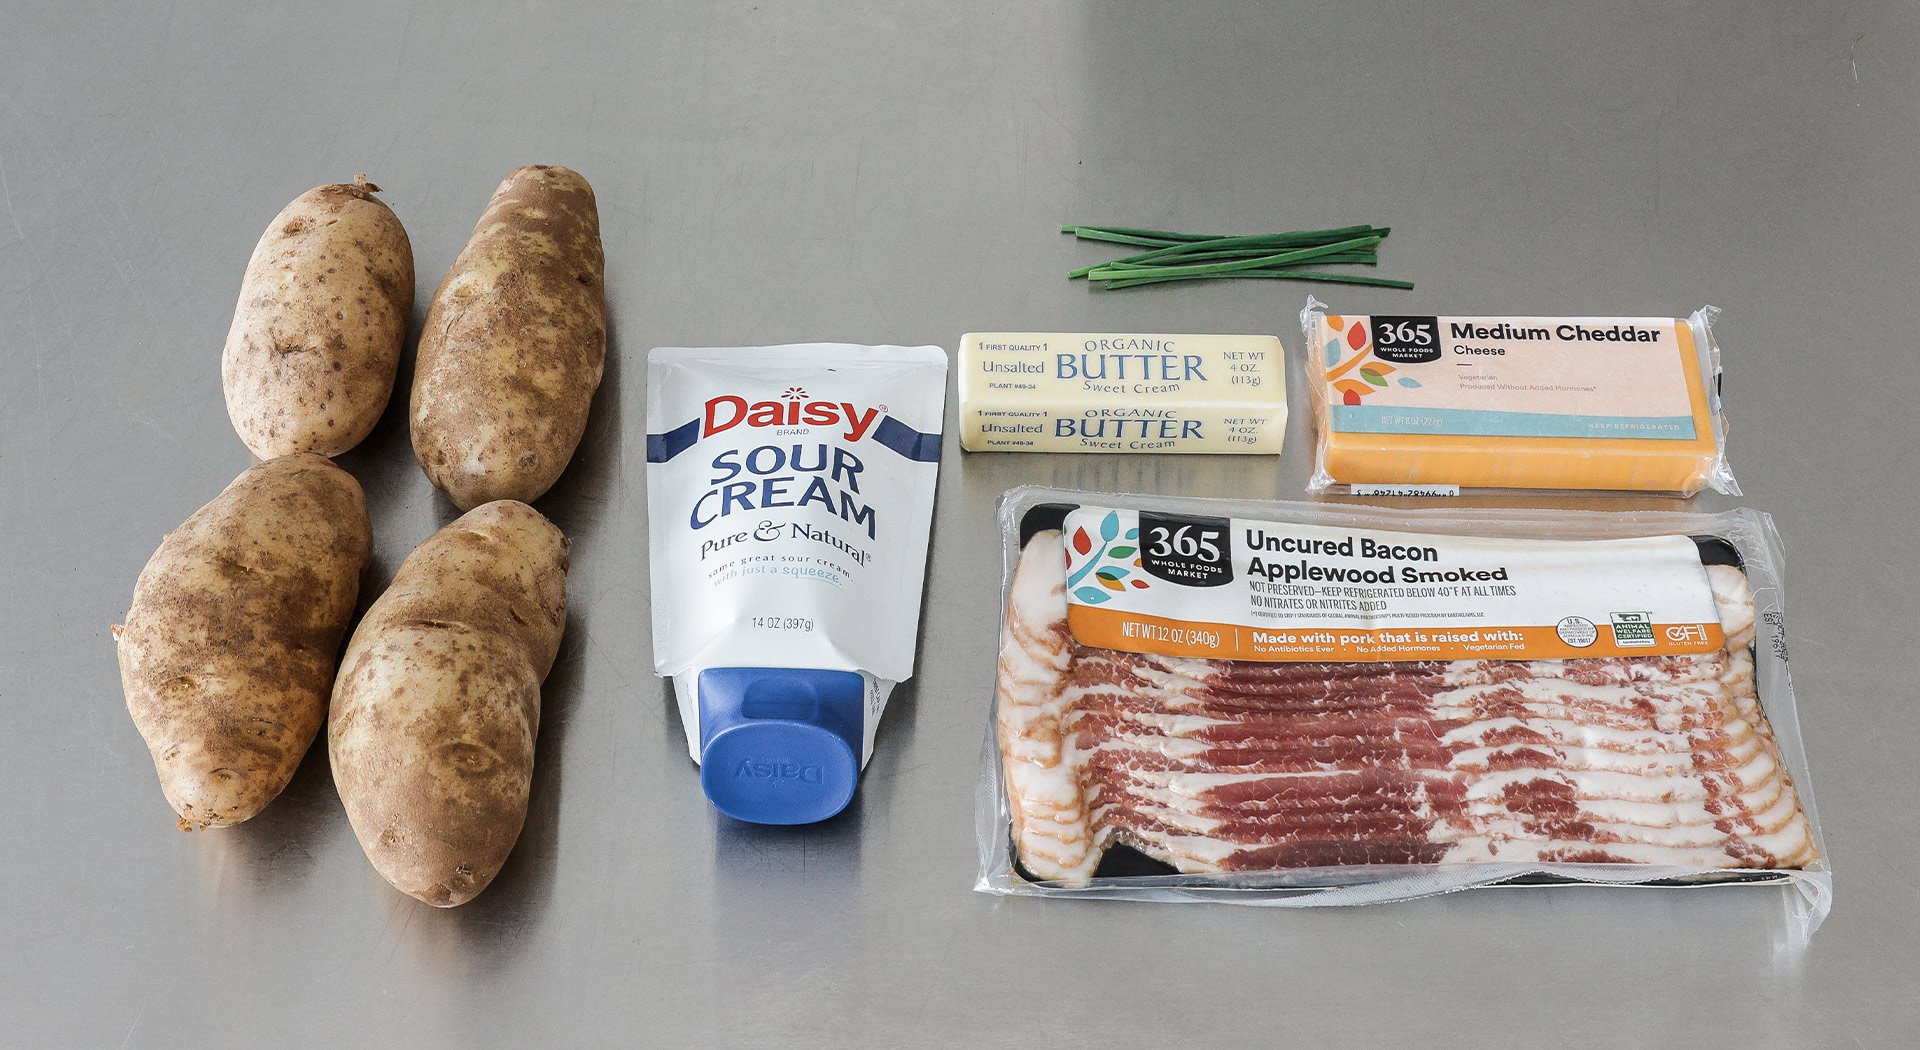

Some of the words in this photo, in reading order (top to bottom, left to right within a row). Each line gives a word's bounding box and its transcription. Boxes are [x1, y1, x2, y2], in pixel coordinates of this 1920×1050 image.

[1378, 321, 1432, 345] 365
[1450, 322, 1550, 340] Medium
[1556, 325, 1661, 343] Cheddar
[978, 342, 983, 350] 1
[1043, 343, 1048, 351] 1
[1085, 339, 1175, 352] ORGANIC
[1453, 345, 1506, 356] Cheese
[1223, 352, 1244, 360] NET
[1248, 352, 1265, 360] WT
[983, 361, 1044, 373] Unsalted
[1056, 353, 1208, 381] BUTTER
[1230, 364, 1236, 372] 4
[1240, 364, 1260, 372] OZ.
[1231, 375, 1261, 387] (113g)
[1458, 374, 1498, 382] Vegetarian
[1083, 380, 1126, 393] Sweet
[1134, 383, 1180, 394] Cream
[1497, 383, 1527, 391] Without
[1085, 408, 1177, 419] ORGANIC
[776, 428, 810, 436] BRAND
[981, 424, 1043, 433] Unsalted
[1055, 418, 1204, 439] BUTTER
[1614, 423, 1680, 431] REFRIGERATED
[1080, 438, 1121, 449] Sweet
[1129, 440, 1176, 449] Cream
[1227, 435, 1257, 444] (113g)
[711, 444, 864, 495] SOUR
[690, 476, 876, 540] CREAM
[701, 531, 748, 561] Pure
[753, 520, 786, 542] &
[791, 523, 865, 568] Natural
[1149, 525, 1220, 562] 365
[1246, 529, 1353, 557] Uncured
[1360, 538, 1438, 562] Bacon
[708, 561, 735, 578] same
[741, 554, 775, 565] great
[1151, 559, 1186, 569] WHOLE
[1190, 563, 1222, 574] FOODS
[1168, 568, 1208, 579] MARKET
[1247, 556, 1395, 584] Applewood
[1401, 567, 1508, 583] Smoked
[714, 569, 738, 587] with
[741, 564, 765, 577] just
[770, 566, 777, 574] a
[782, 566, 842, 586] squeeze.
[1249, 580, 1265, 593] NOT
[1344, 587, 1404, 599] REFRIGERATED
[1406, 587, 1435, 598] BELOW
[1461, 586, 1471, 597] AT
[1474, 586, 1489, 597] ALL
[1490, 585, 1517, 596] TIMES
[1250, 594, 1262, 607] NO
[1264, 597, 1304, 609] NITRATES
[1305, 598, 1318, 609] OR
[1320, 599, 1357, 611] NITRITES
[1359, 600, 1387, 612] ADDED
[752, 617, 764, 628] 14
[767, 617, 781, 629] OZ
[783, 617, 814, 632] (397g)
[1122, 621, 1140, 638] NET
[1142, 623, 1156, 639] WT
[1158, 626, 1169, 641] 12
[1171, 629, 1184, 643] OZ
[1185, 629, 1220, 648] (340g)
[1252, 631, 1297, 644] Made
[1301, 632, 1335, 643] with
[1340, 633, 1375, 646] pork
[1379, 632, 1411, 643] that
[1414, 632, 1427, 643] is
[1432, 631, 1479, 643] raised
[1483, 630, 1524, 641] with:
[1268, 645, 1314, 653] Antibiotics
[1315, 645, 1334, 653] Ever
[1370, 645, 1396, 653] Added
[1463, 644, 1507, 652] Vegetarian
[735, 759, 823, 784] Daisy
